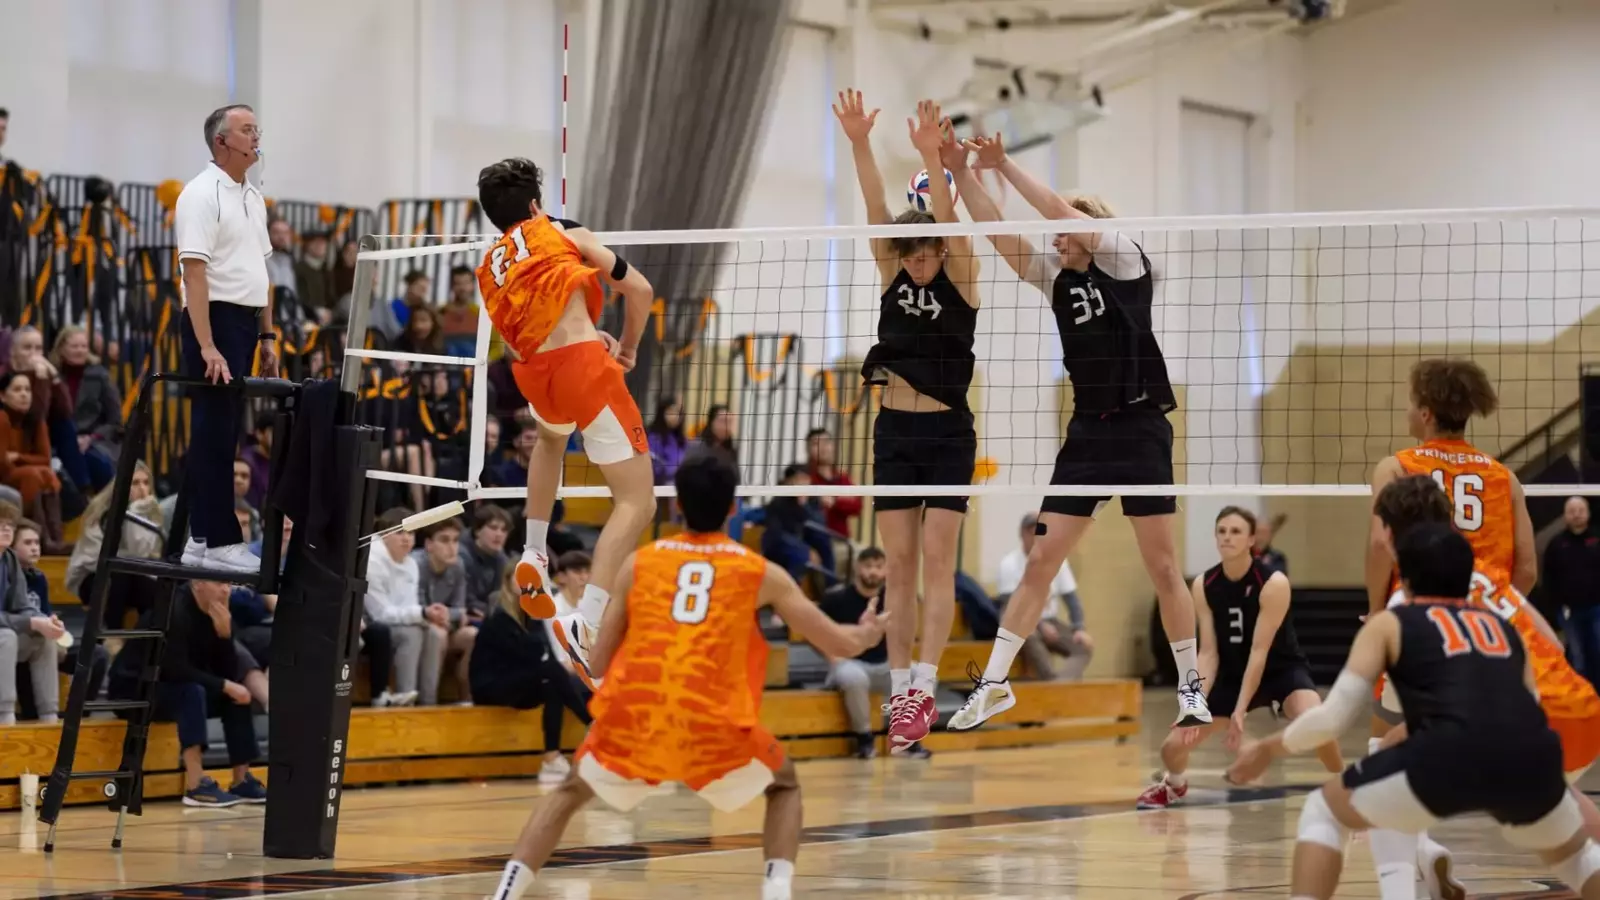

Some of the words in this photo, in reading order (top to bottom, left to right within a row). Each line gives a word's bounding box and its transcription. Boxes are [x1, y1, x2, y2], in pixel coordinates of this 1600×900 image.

[897, 283, 943, 320] 24
[1415, 448, 1491, 466] PRINCETON
[671, 560, 716, 624] 8
[1466, 571, 1518, 620] 2
[1228, 606, 1244, 643] 3
[1425, 605, 1512, 659] 10
